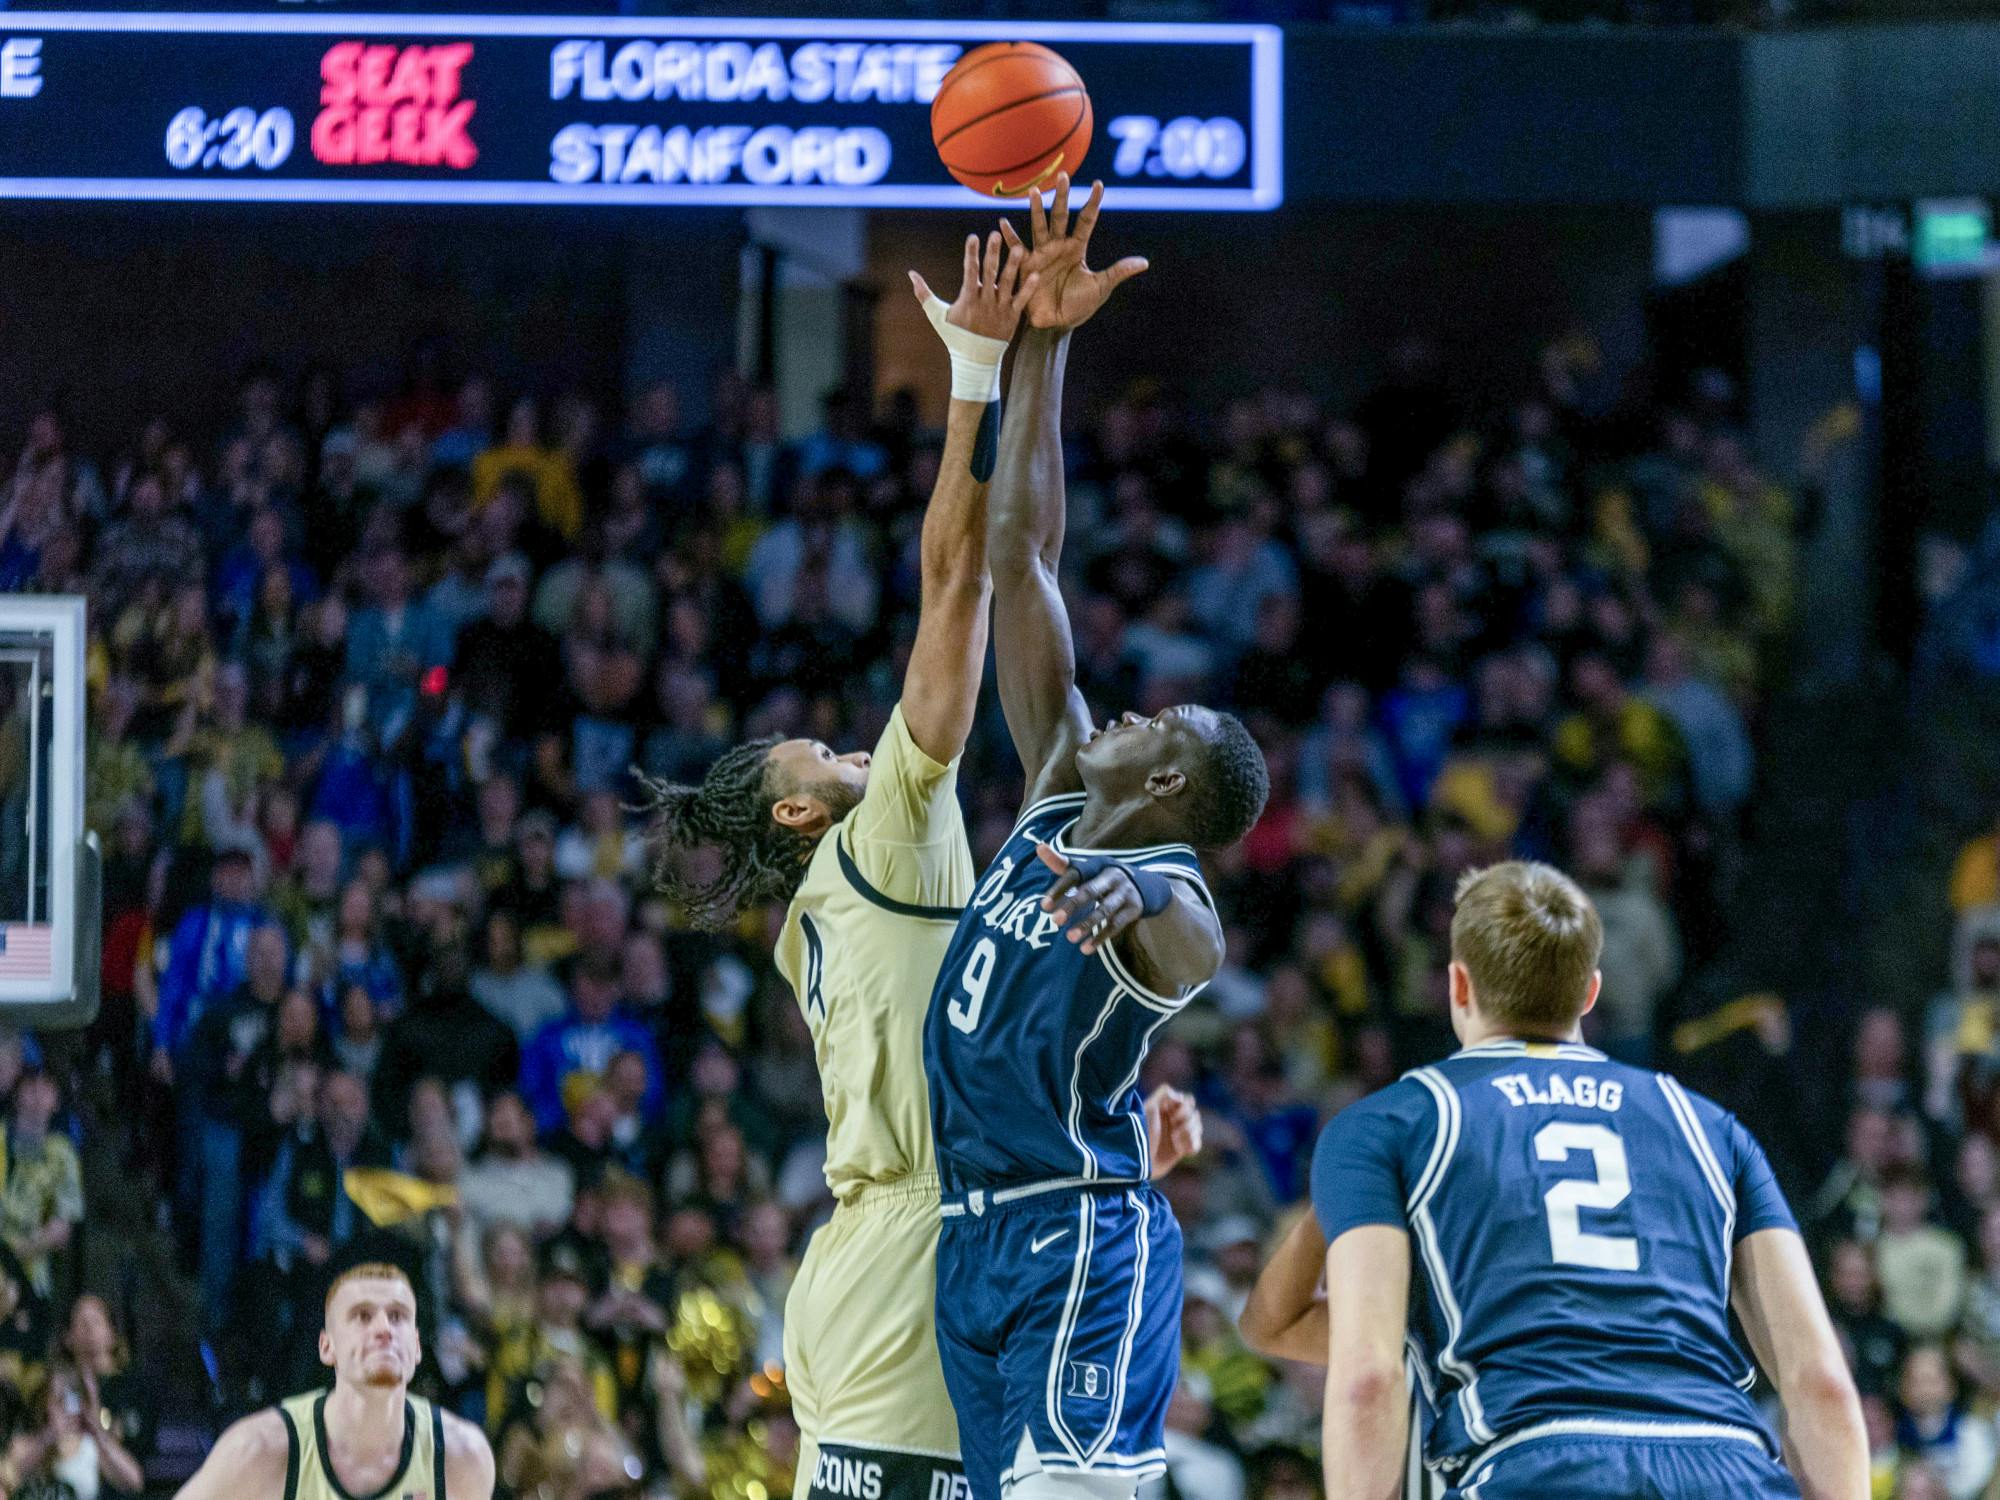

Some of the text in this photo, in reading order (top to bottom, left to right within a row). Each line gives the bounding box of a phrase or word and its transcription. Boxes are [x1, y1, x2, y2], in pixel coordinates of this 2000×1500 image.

[320, 41, 474, 104] SEAT
[550, 40, 963, 104] FLORIDA STATE
[166, 106, 295, 169] 6:30
[311, 100, 480, 169] GEEK
[550, 122, 892, 184] STANFORD
[1107, 115, 1246, 179] 7:00
[947, 936, 997, 1035] 9
[1491, 1073, 1624, 1112] FLAGG
[1533, 1121, 1640, 1271] 2
